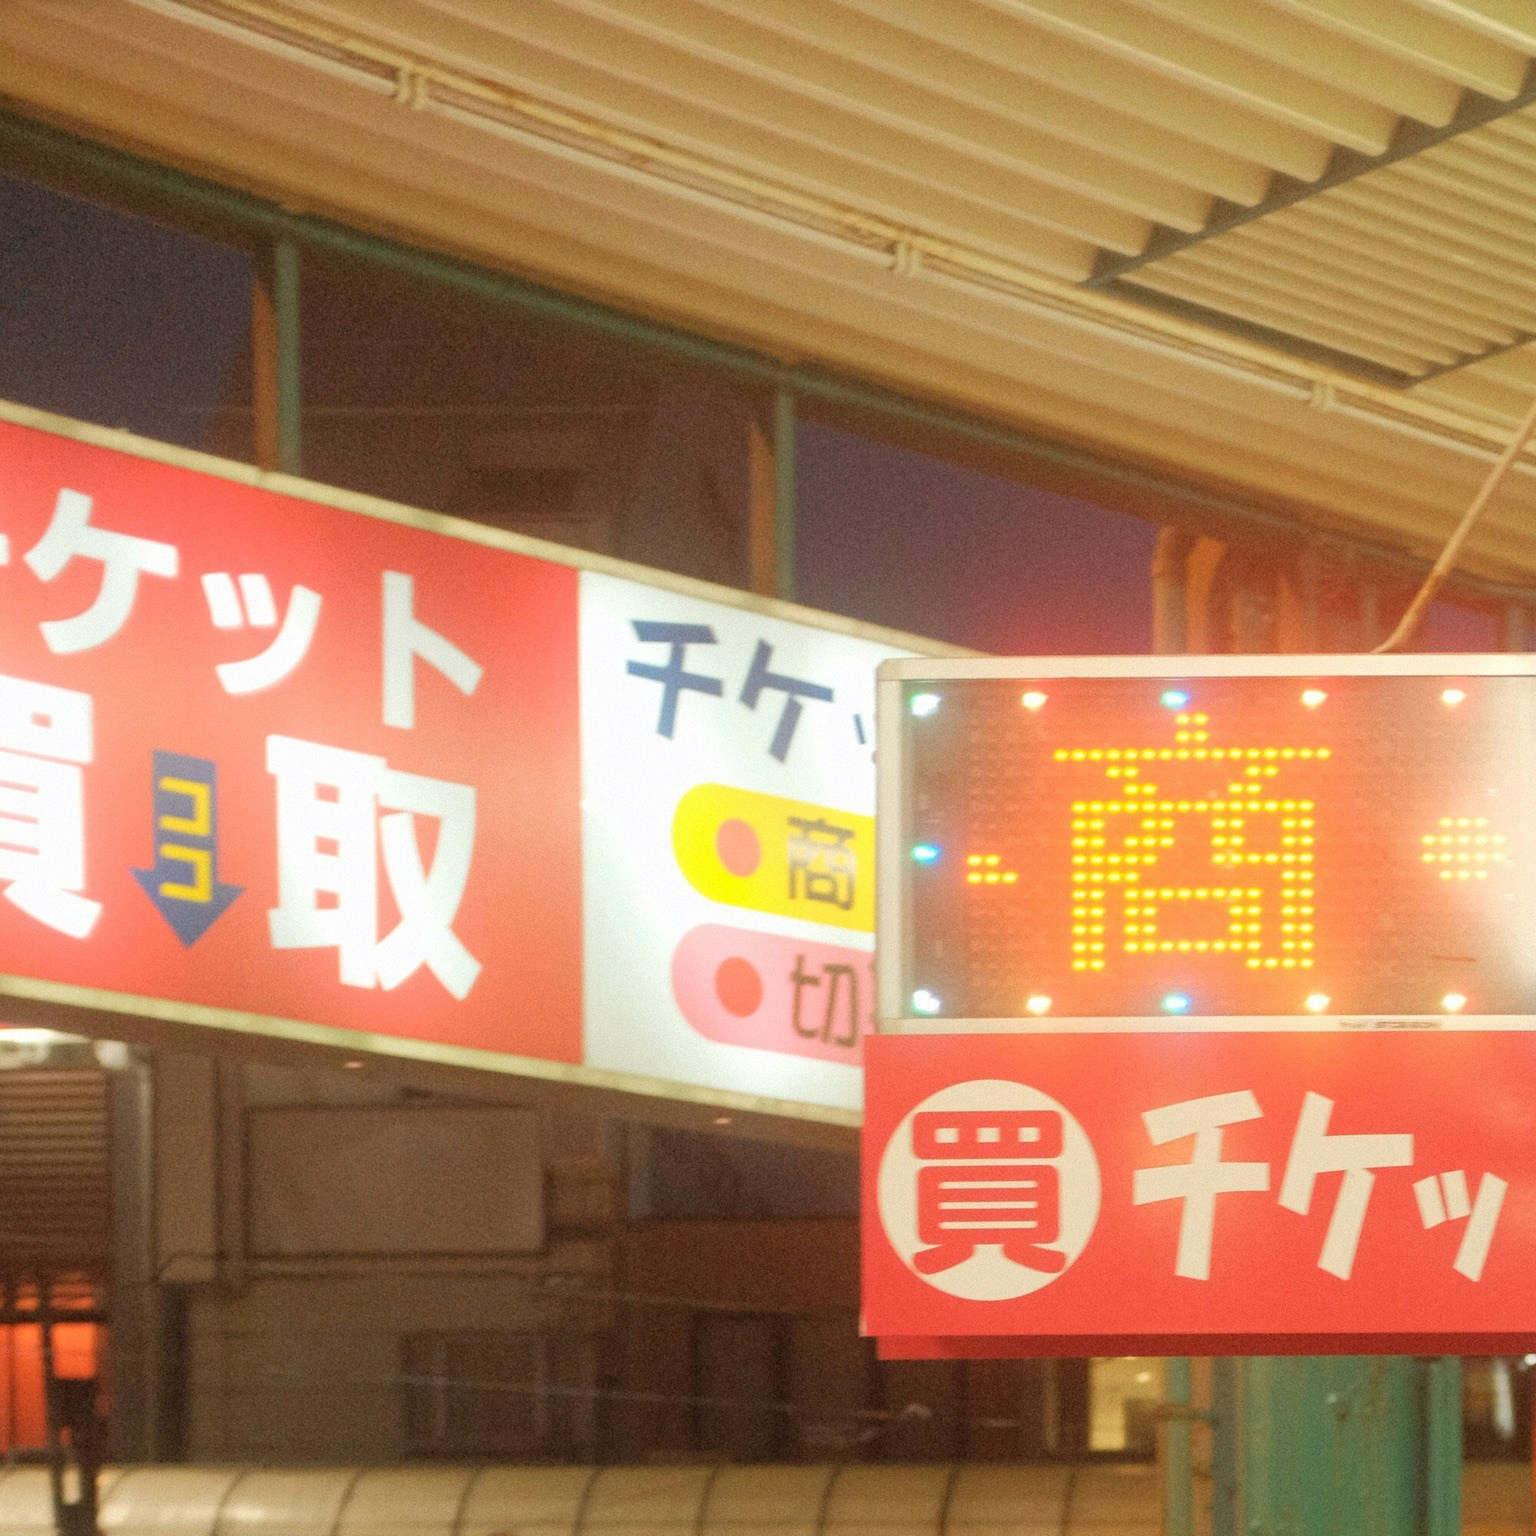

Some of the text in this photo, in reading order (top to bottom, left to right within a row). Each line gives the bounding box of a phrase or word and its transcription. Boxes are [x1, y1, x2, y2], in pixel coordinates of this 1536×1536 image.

[0, 487, 484, 730] ケット
[626, 619, 867, 764] チケ
[158, 776, 213, 904] ココ
[790, 955, 877, 1048] 切
